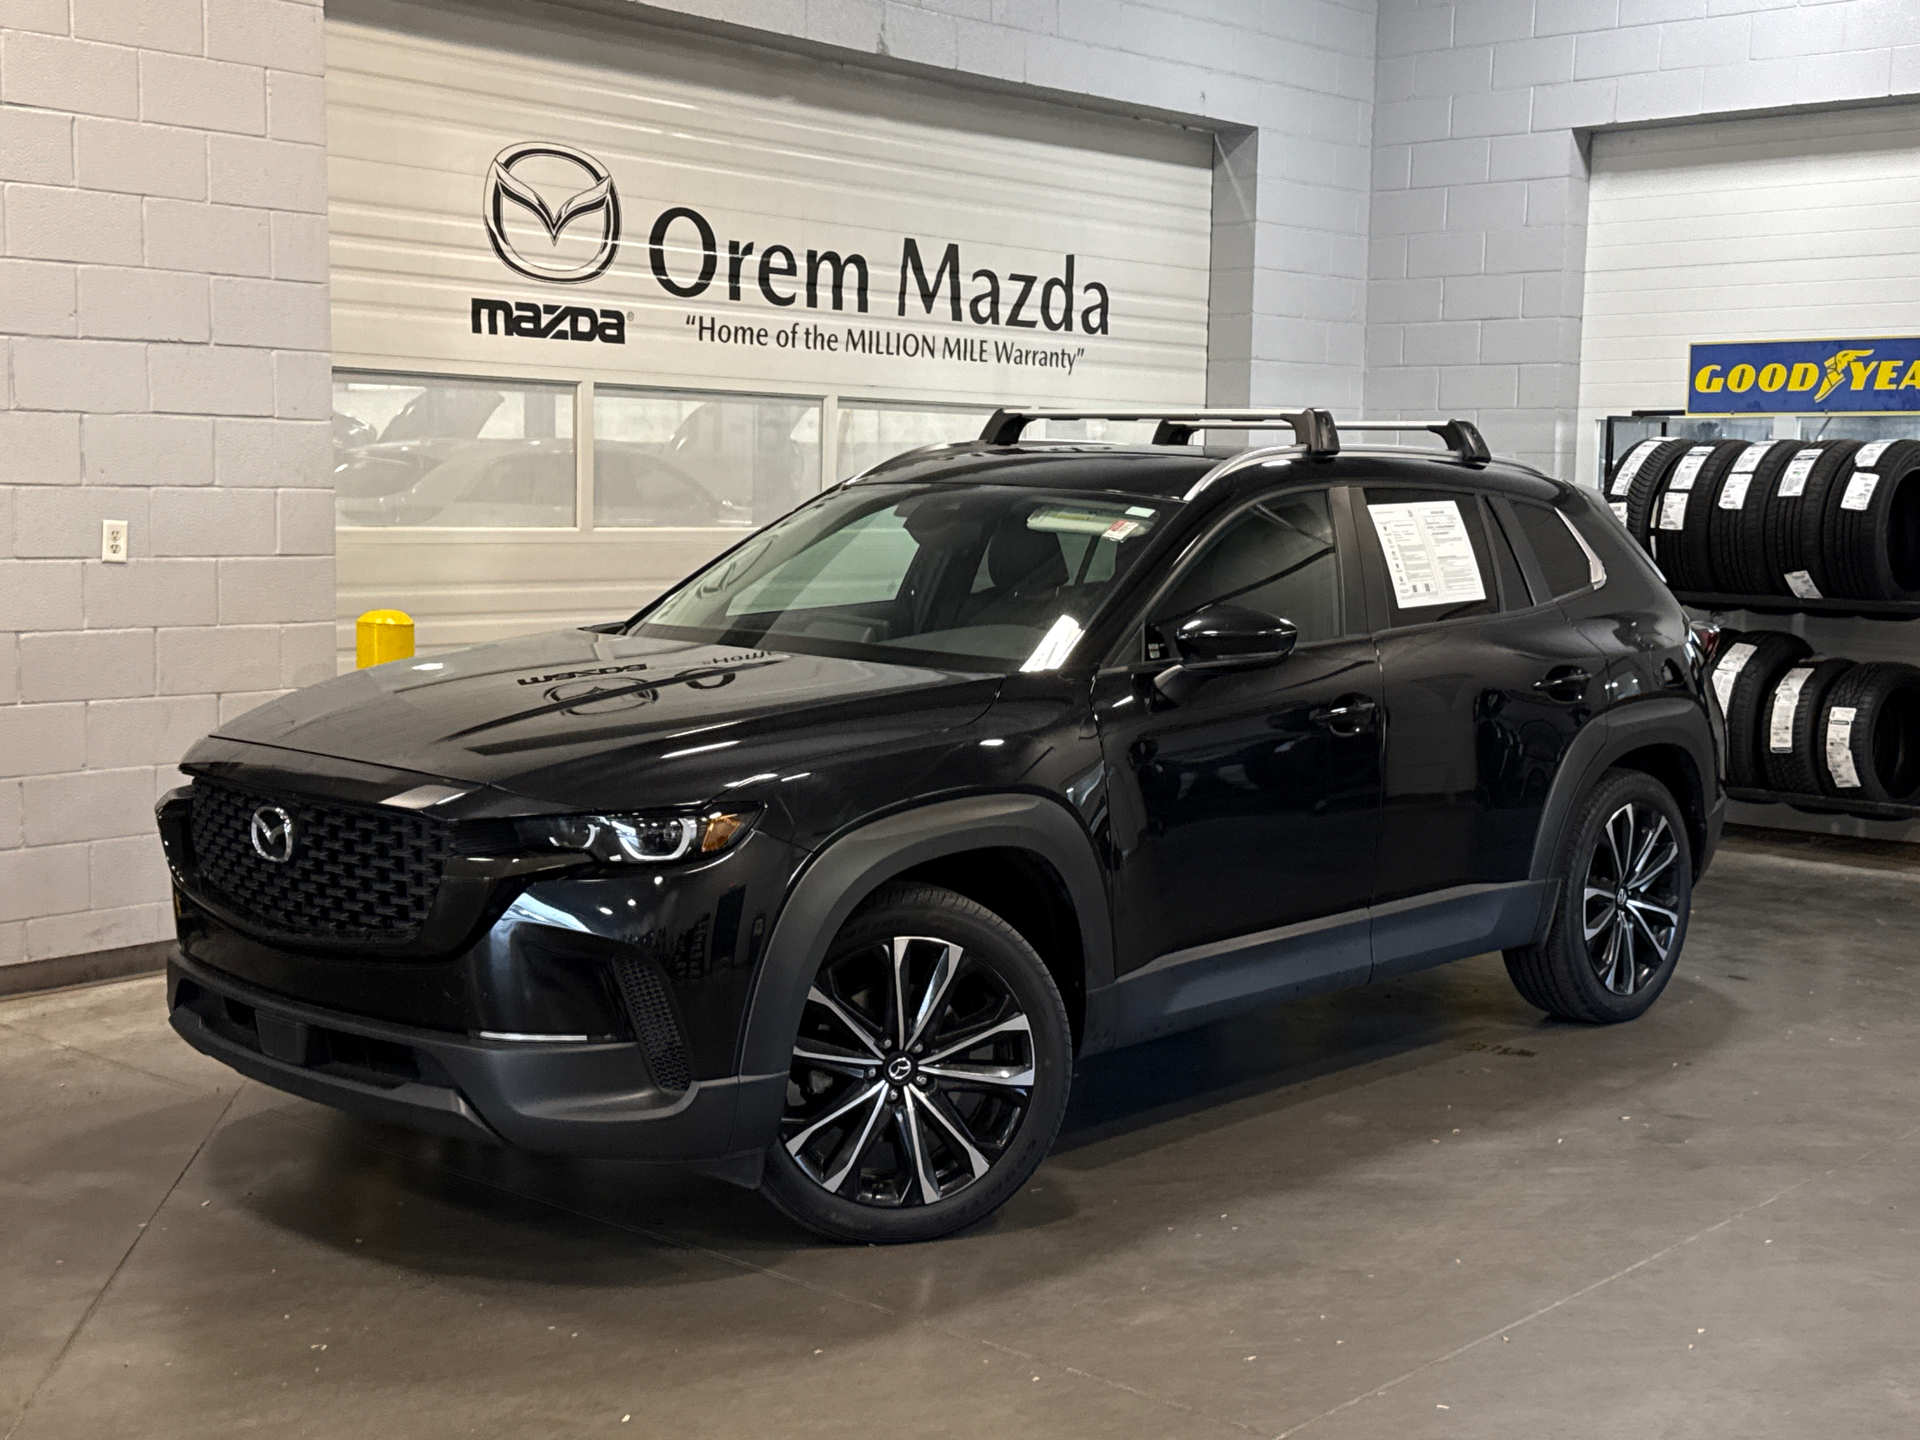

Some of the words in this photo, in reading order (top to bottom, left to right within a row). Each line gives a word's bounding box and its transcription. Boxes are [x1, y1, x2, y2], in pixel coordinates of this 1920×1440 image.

[648, 206, 869, 313] Orem
[897, 237, 1110, 335] Mazda
[776, 322, 800, 349] of
[803, 324, 839, 352] the
[845, 328, 936, 359] MILLION
[942, 336, 988, 363] MILE
